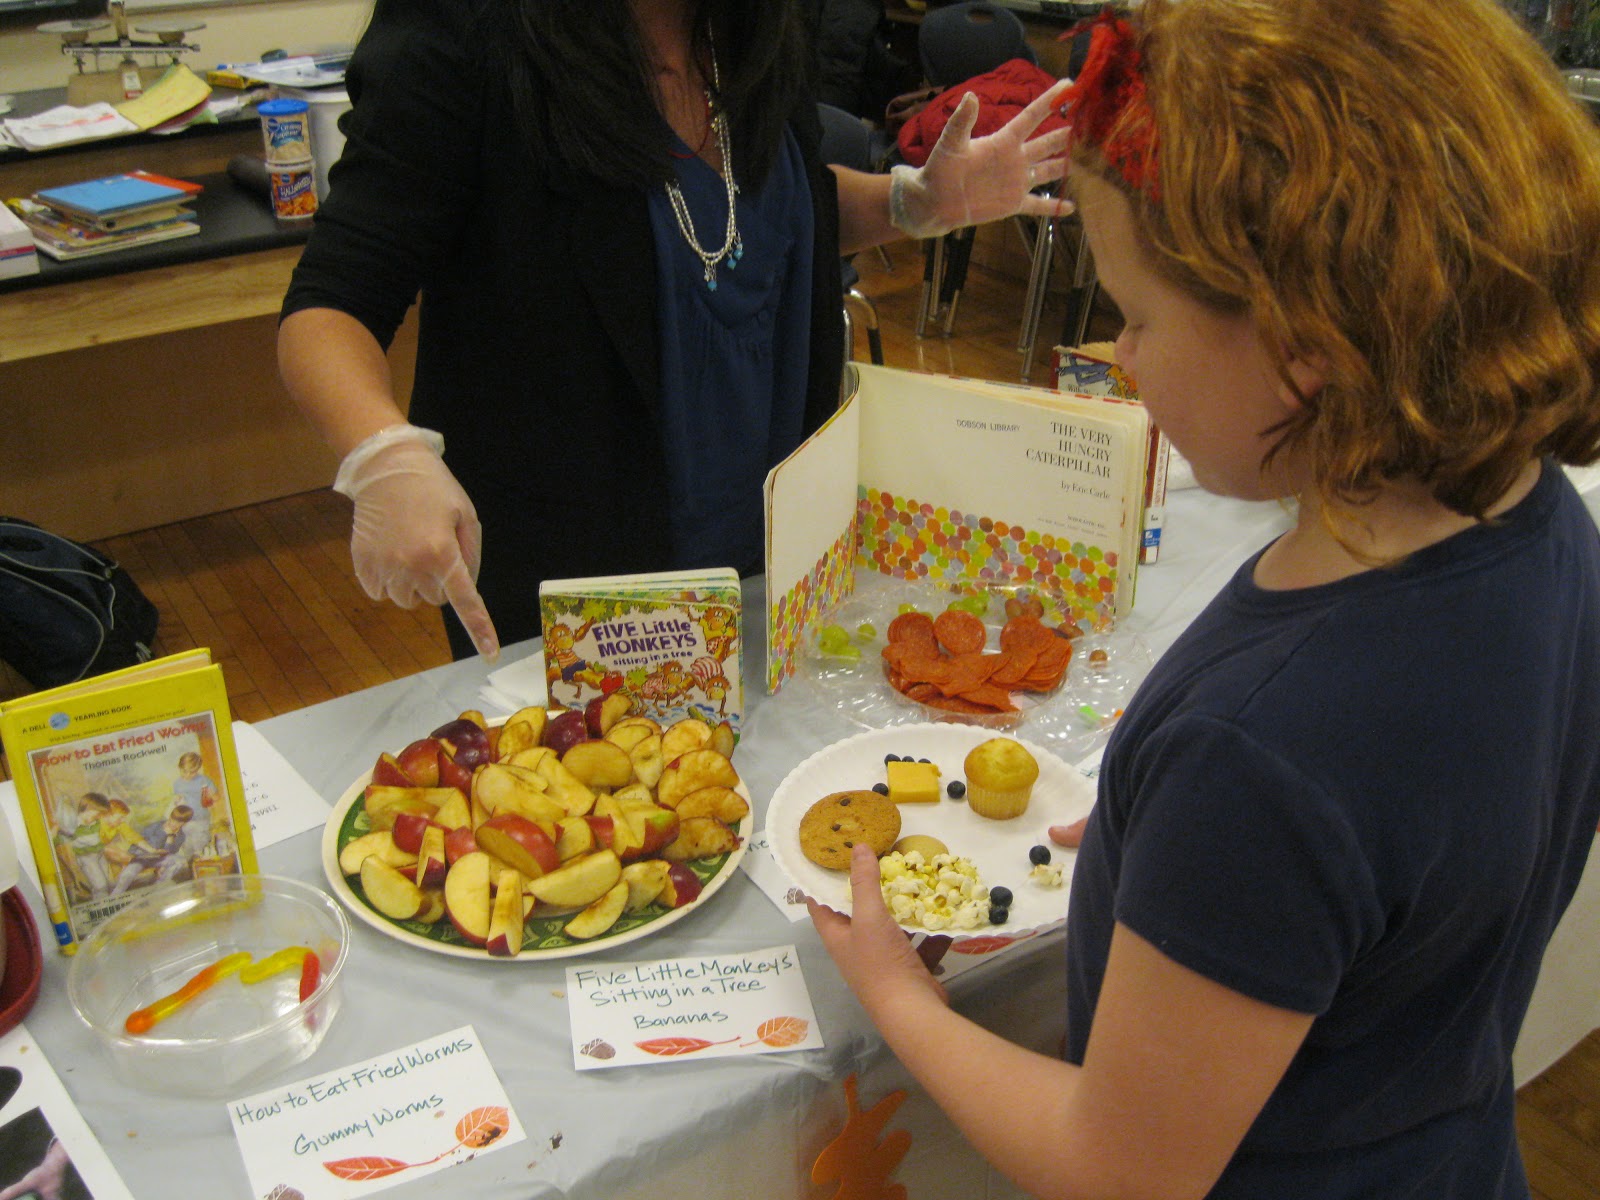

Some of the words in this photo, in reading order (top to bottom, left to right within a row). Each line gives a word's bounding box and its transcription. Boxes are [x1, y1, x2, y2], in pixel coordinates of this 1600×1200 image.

[956, 419, 987, 430] DOBSON
[989, 423, 1021, 432] LIBRARY
[1050, 421, 1078, 439] THE
[1081, 427, 1113, 447] VERY
[1026, 449, 1111, 478] CATERPILLAR
[1059, 440, 1113, 462] HUNGRY
[1061, 480, 1071, 492] by
[1072, 482, 1088, 495] Eric
[1089, 487, 1111, 499] Carle
[592, 621, 637, 642] FIVE
[642, 618, 691, 634] Little
[597, 632, 697, 658] MONKEYS
[613, 655, 649, 667] sitting
[650, 653, 661, 662] in
[662, 652, 669, 660] a
[671, 649, 693, 659] tree
[29, 723, 47, 732] DELL
[74, 709, 110, 722] YEARLING
[111, 704, 132, 714] BOOK
[36, 750, 72, 767] How
[74, 747, 91, 760] to
[93, 741, 116, 756] Eat
[119, 731, 155, 748] Fried
[157, 719, 207, 740] Worms
[83, 756, 121, 771] Thomas
[123, 744, 168, 761] Rockwell
[576, 969, 632, 989] Five
[635, 962, 695, 983] Little
[590, 986, 672, 1008] Sitting
[672, 983, 694, 997] in
[701, 985, 713, 995] a
[713, 976, 766, 993] Tree
[633, 1010, 729, 1029] Bananas
[236, 1101, 282, 1125] How
[284, 1091, 308, 1109] to
[307, 1077, 351, 1103] Eat
[351, 1054, 407, 1089] Fried
[406, 1037, 473, 1069] Worms
[293, 1119, 374, 1155] Gummy
[372, 1093, 444, 1124] Worms
